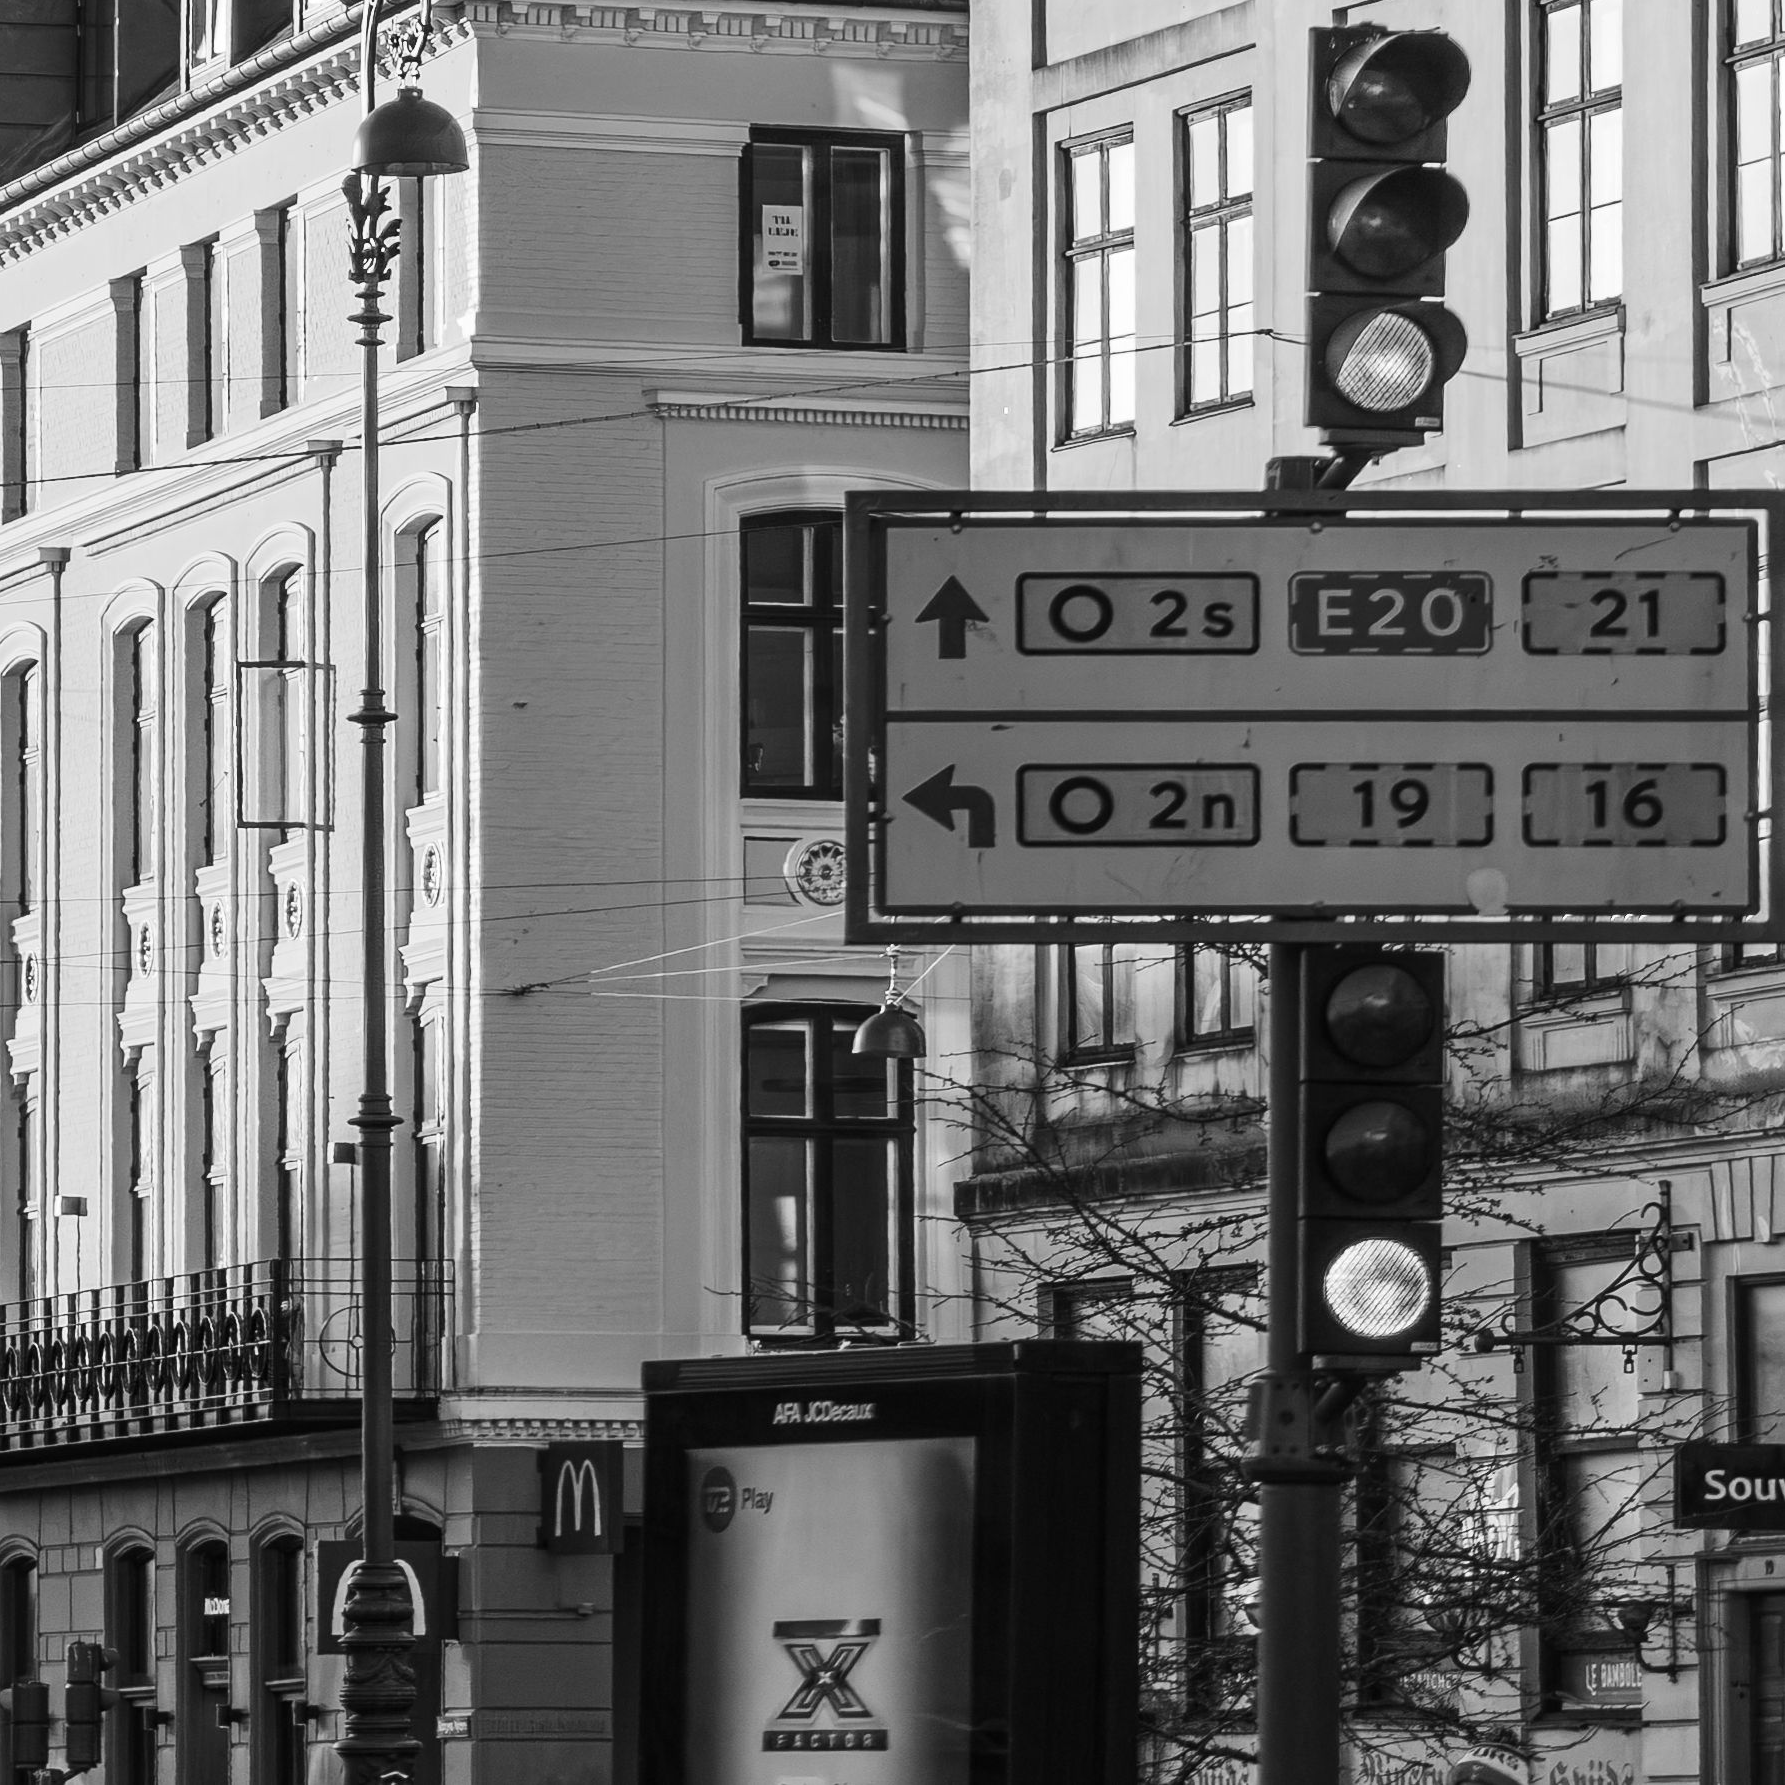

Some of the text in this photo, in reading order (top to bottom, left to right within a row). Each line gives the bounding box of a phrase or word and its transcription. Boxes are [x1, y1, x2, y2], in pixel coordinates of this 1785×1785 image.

[1148, 589, 1235, 639] 2s
[1317, 586, 1464, 638] E20
[1588, 587, 1661, 639] 21
[1148, 780, 1235, 831] 2n
[1352, 777, 1429, 830] 19
[1584, 778, 1664, 831] 16
[773, 1401, 876, 1424] AFA JCDecaux
[741, 1487, 774, 1514] Play
[776, 1641, 876, 1720] X
[776, 1733, 873, 1748] FACTOR
